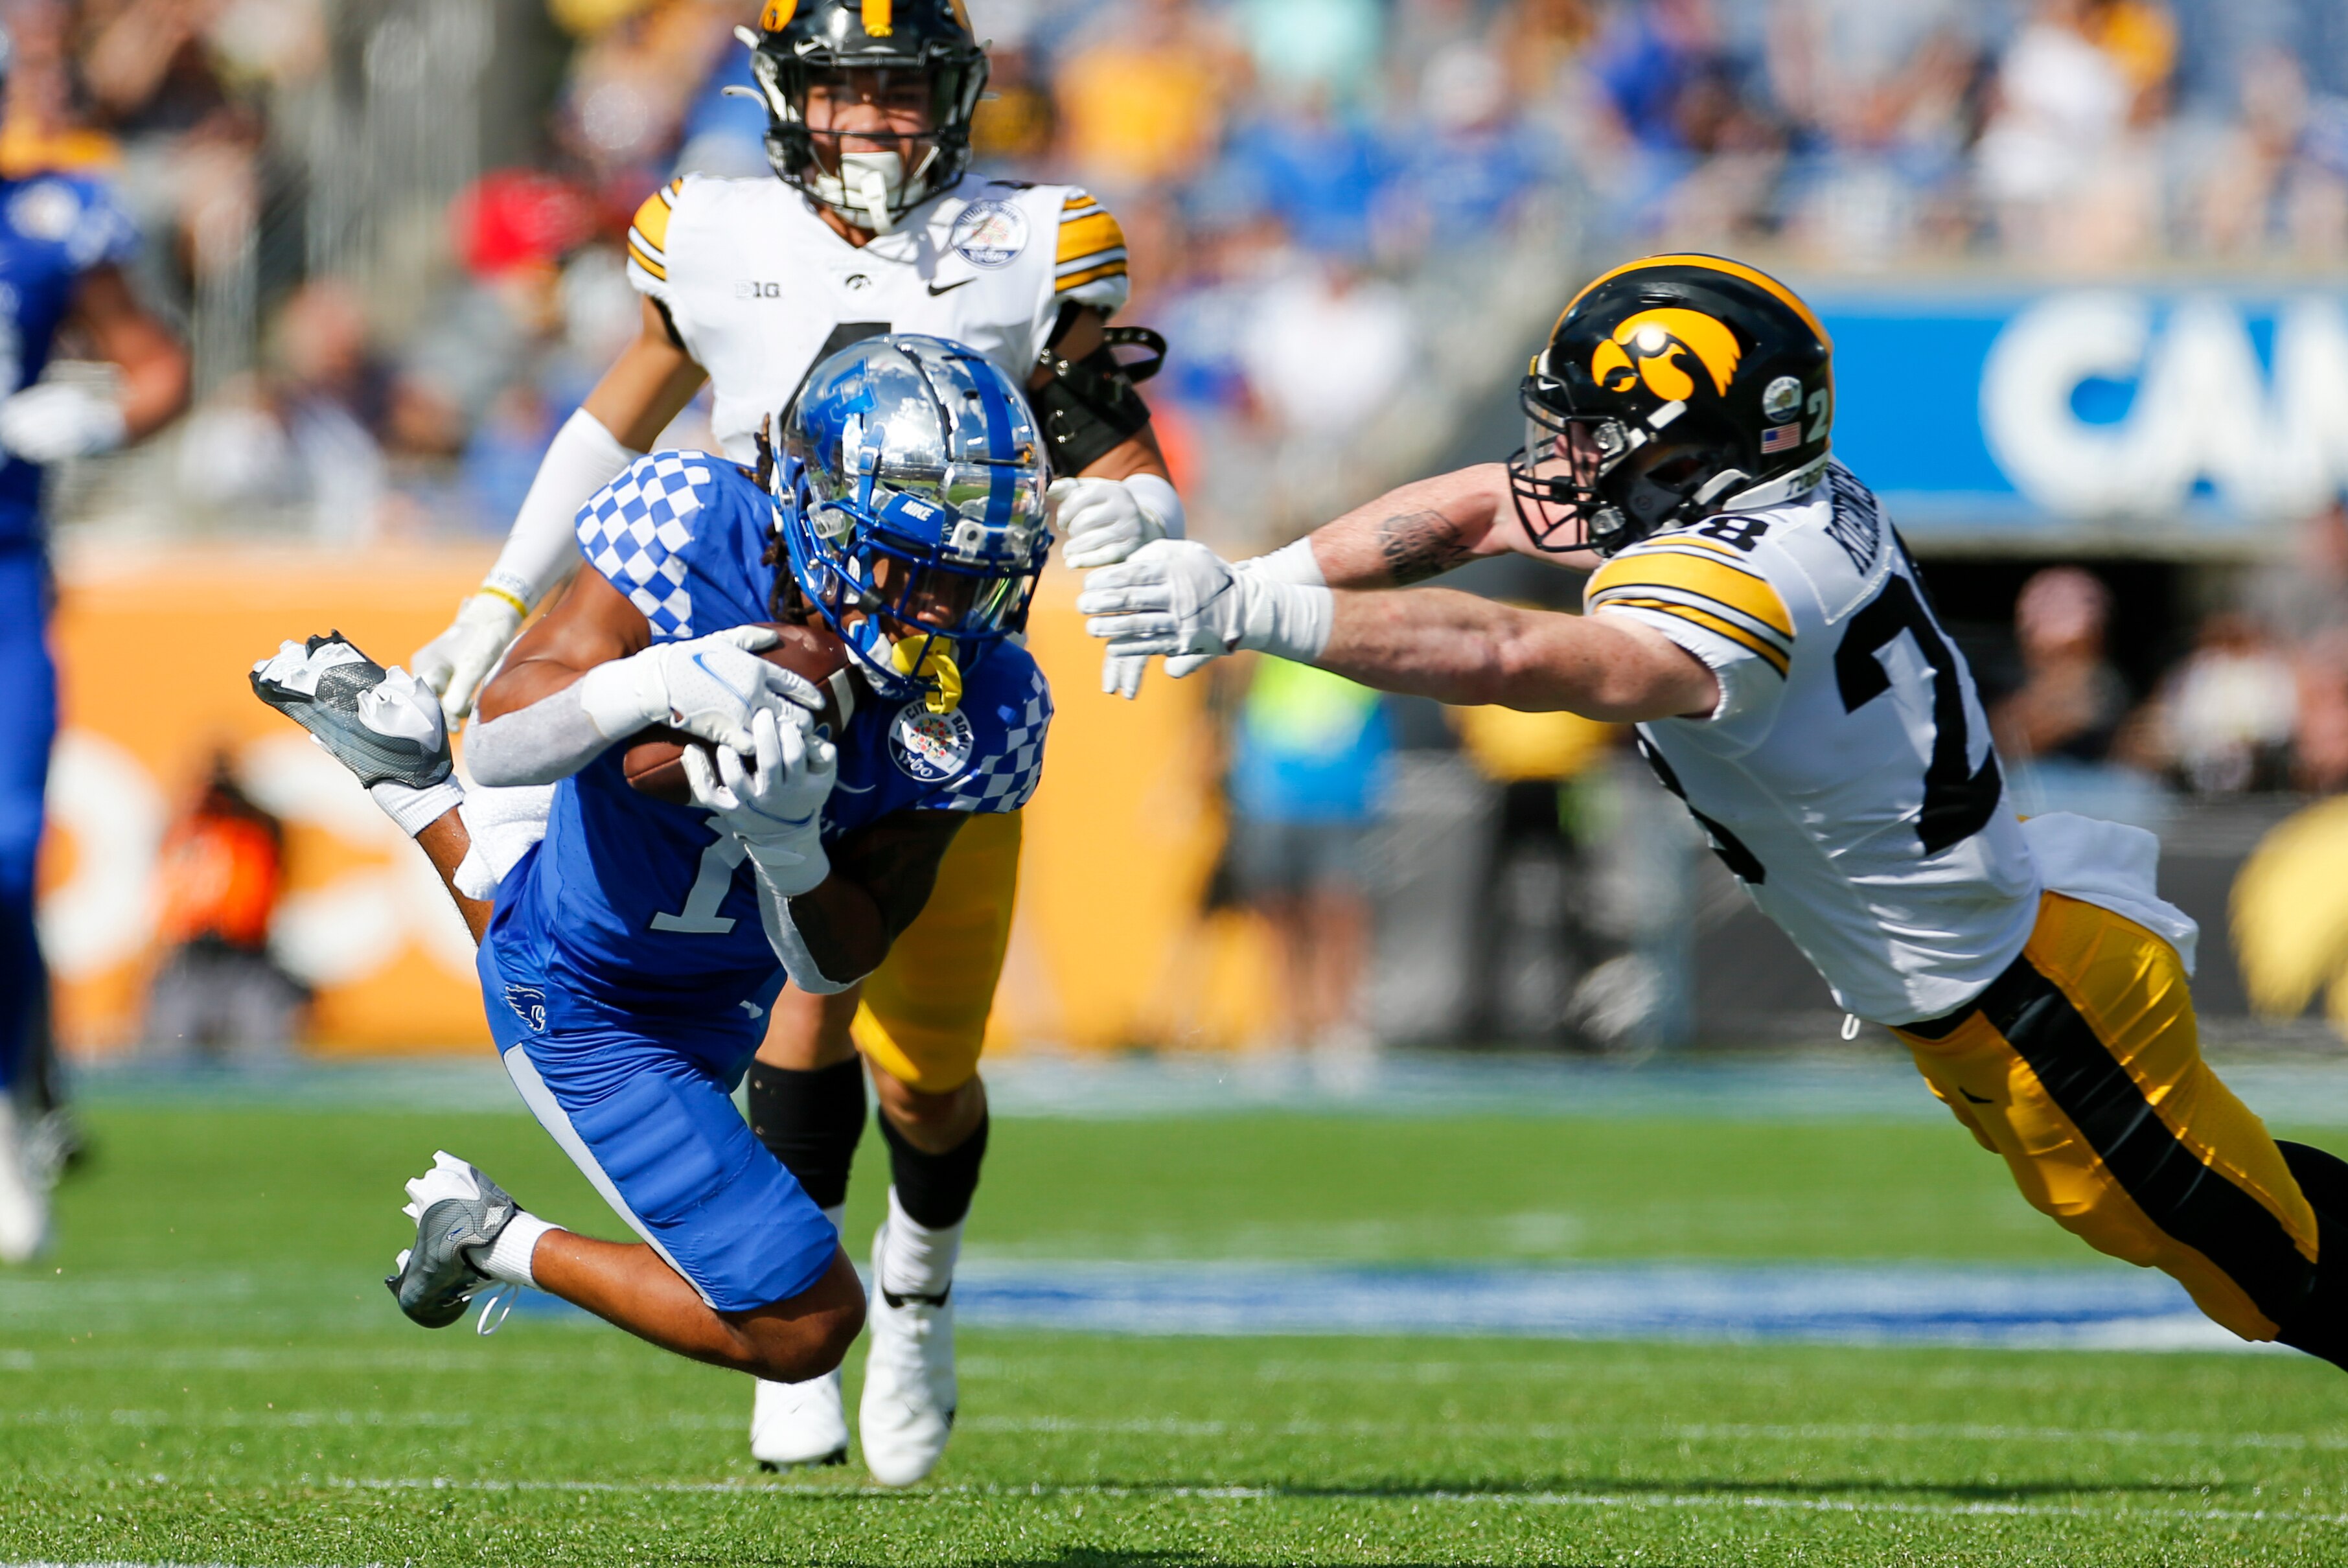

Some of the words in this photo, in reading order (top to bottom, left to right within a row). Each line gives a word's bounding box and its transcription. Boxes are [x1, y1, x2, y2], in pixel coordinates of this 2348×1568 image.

[1806, 388, 1829, 443] 2
[901, 500, 935, 522] NIKE
[904, 702, 950, 720] CIT
